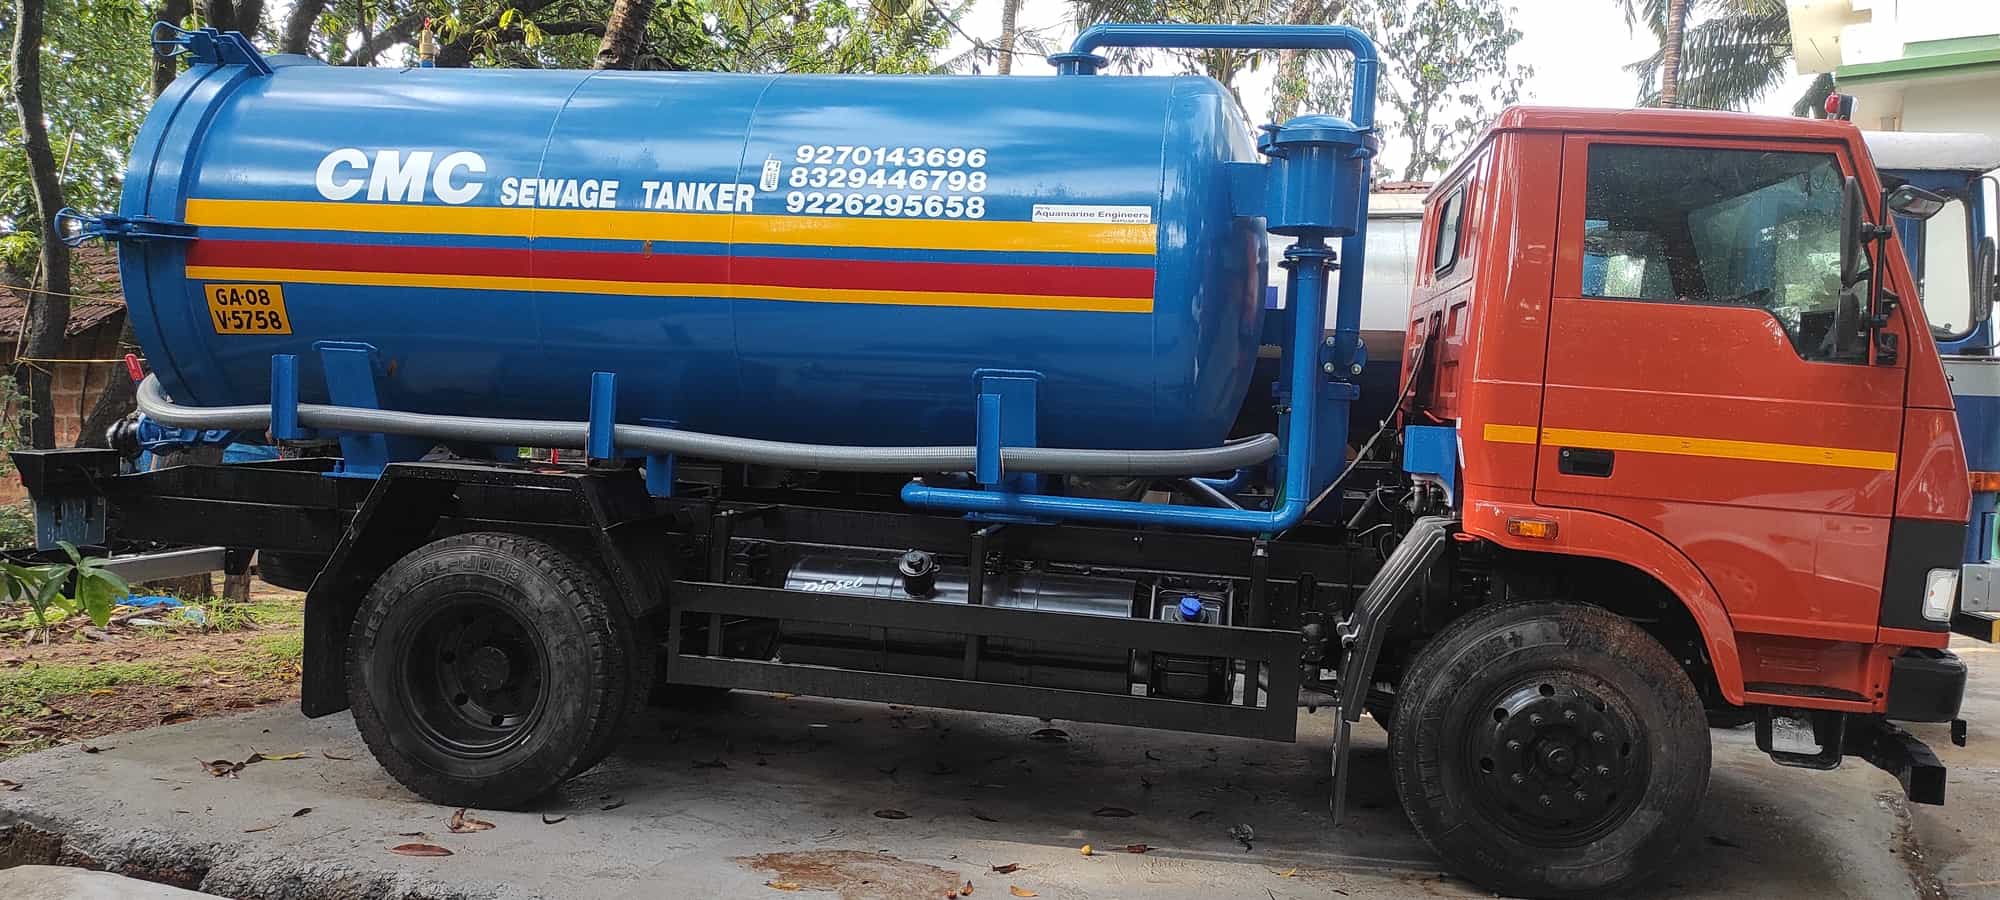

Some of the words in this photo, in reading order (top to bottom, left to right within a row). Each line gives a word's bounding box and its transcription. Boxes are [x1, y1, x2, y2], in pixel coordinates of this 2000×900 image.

[796, 144, 987, 168] 9270143696
[315, 148, 487, 204] CMC
[500, 177, 619, 209] SEWAGE
[642, 181, 755, 212] TANKER
[789, 166, 987, 193] 8329446798
[786, 191, 985, 219] 9226295658
[1034, 209, 1095, 218] Aquamarine
[1098, 211, 1149, 219] Engineers
[802, 577, 863, 592] Diesel
